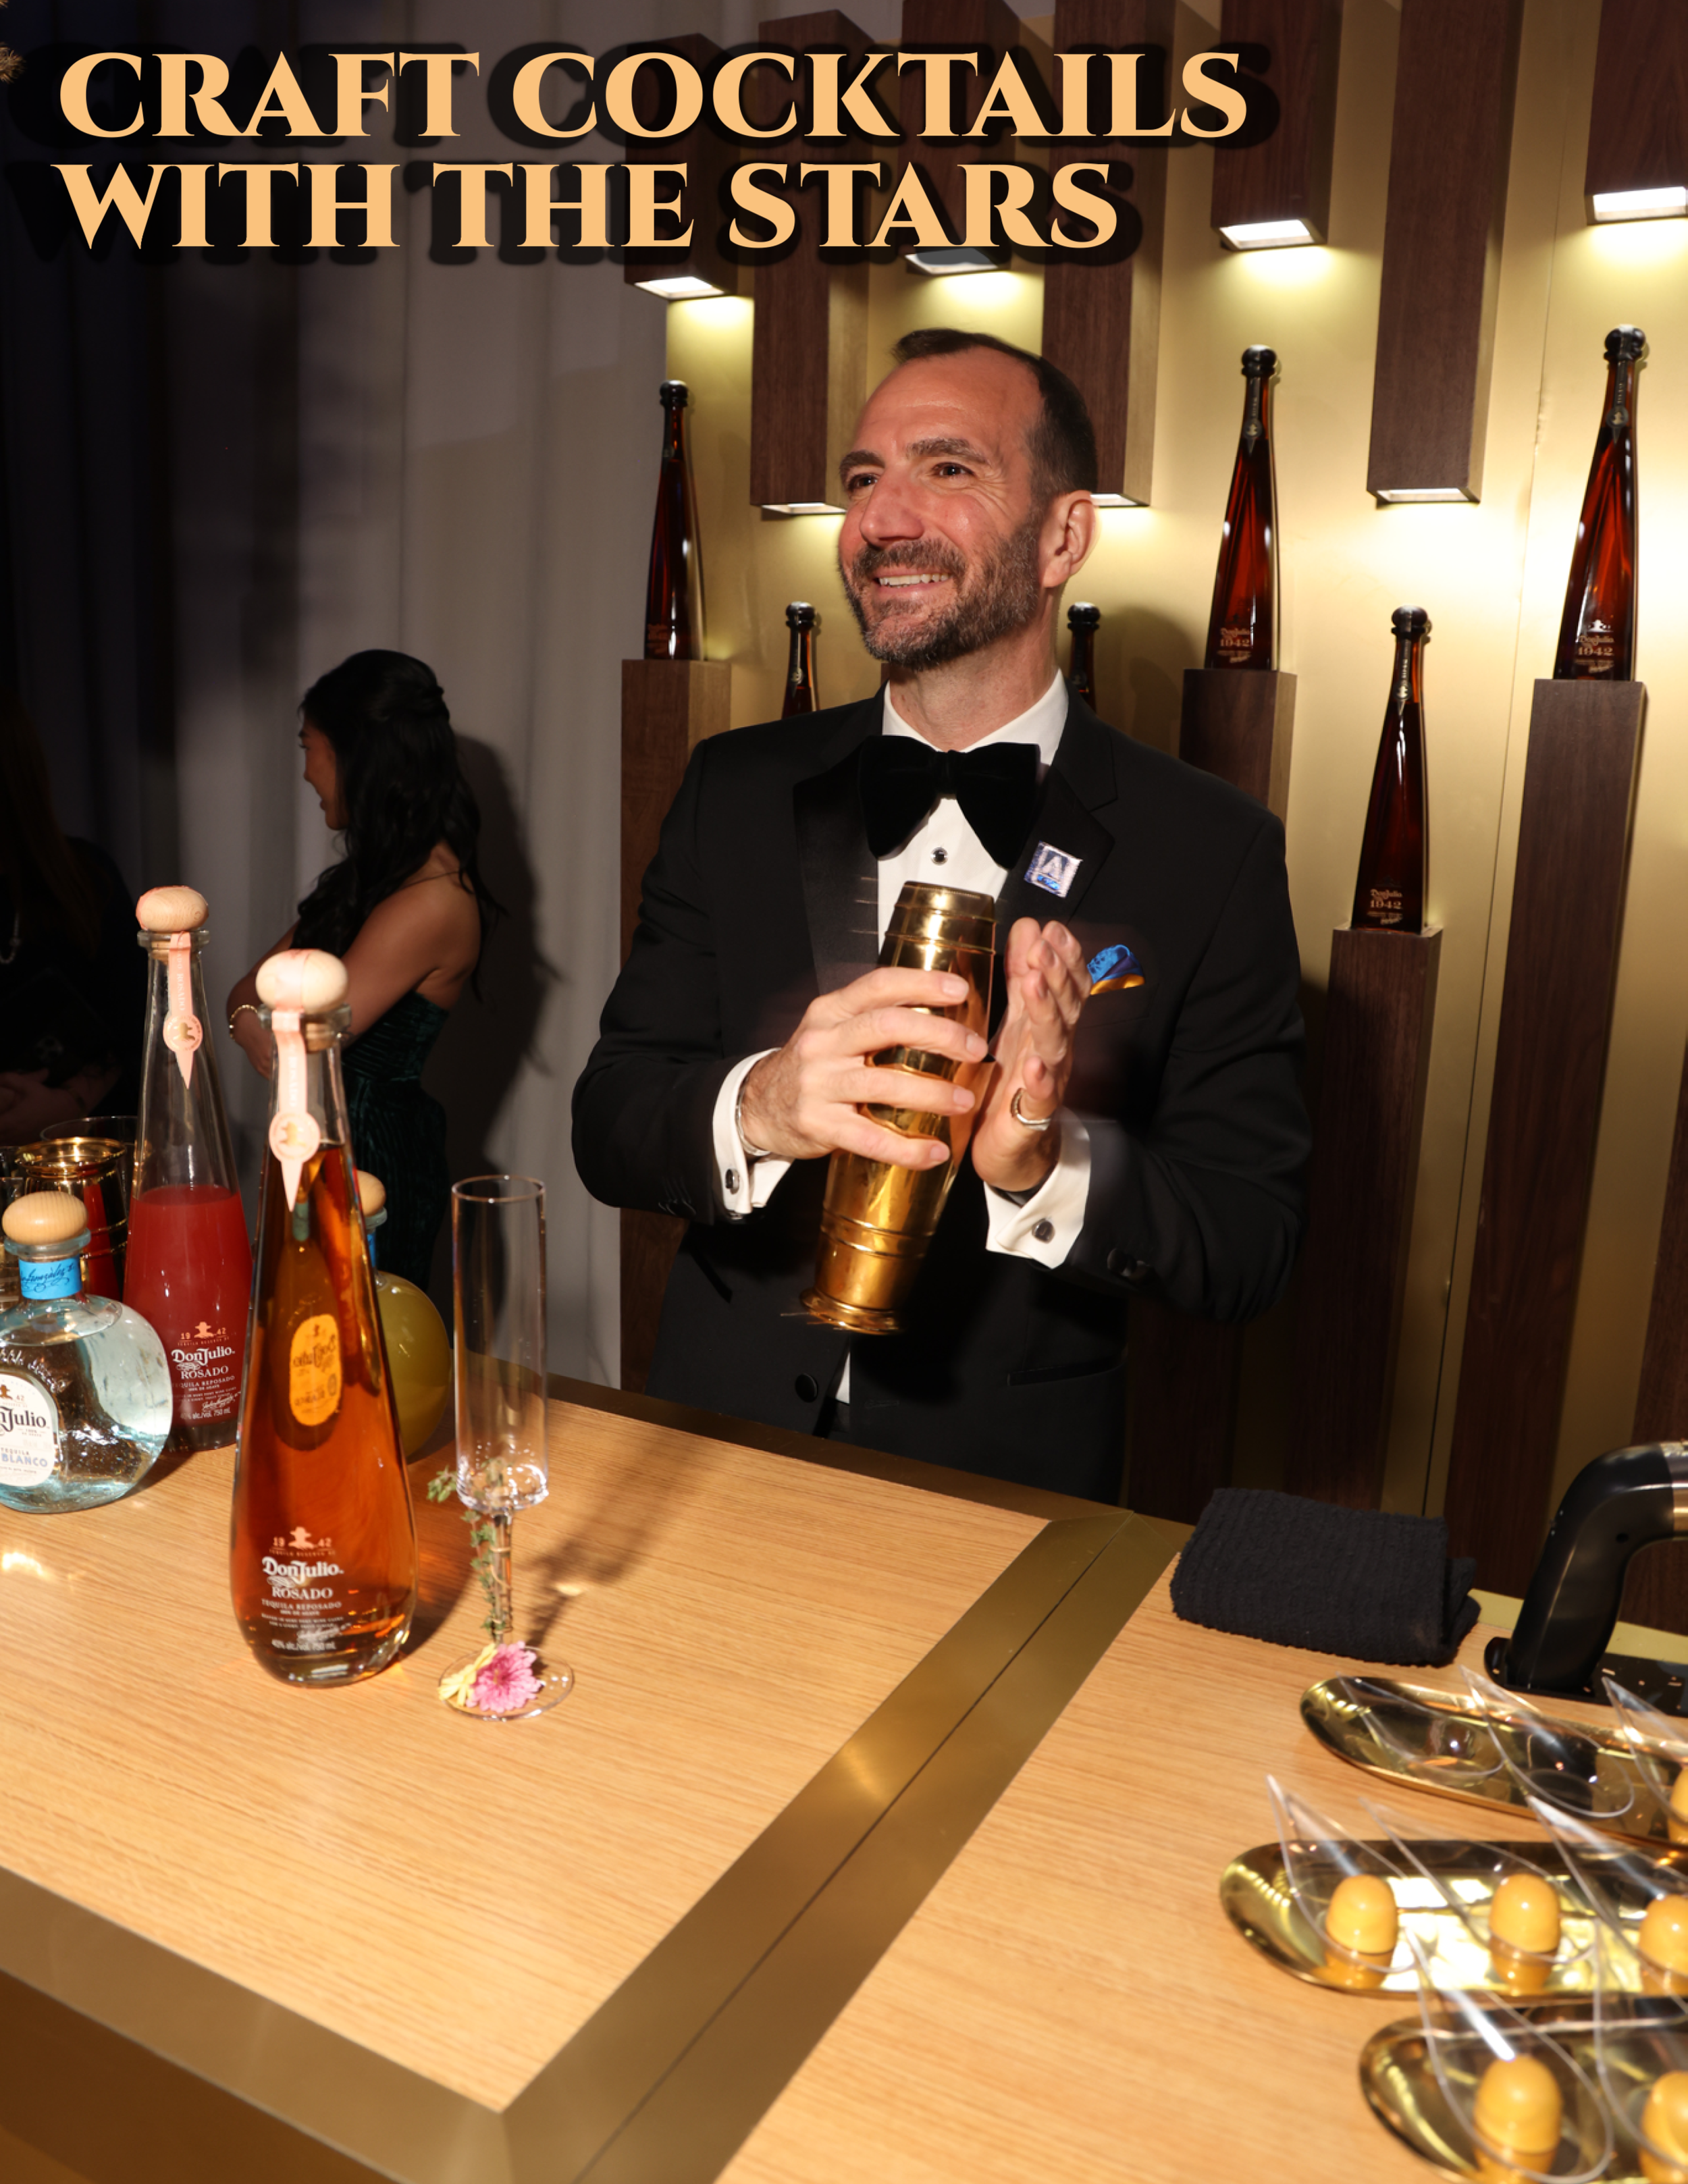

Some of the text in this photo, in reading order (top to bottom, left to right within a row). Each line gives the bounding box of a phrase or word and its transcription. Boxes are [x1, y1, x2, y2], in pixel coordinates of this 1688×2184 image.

[216, 1327, 227, 1335] 42
[180, 1365, 229, 1380] ROSADO
[202, 1375, 235, 1386] REPOSADO
[1, 1453, 48, 1468] BLANCO
[273, 1537, 332, 1547] 19 42
[271, 1586, 334, 1600] ROSADO
[296, 1601, 342, 1610] REPOSADO
